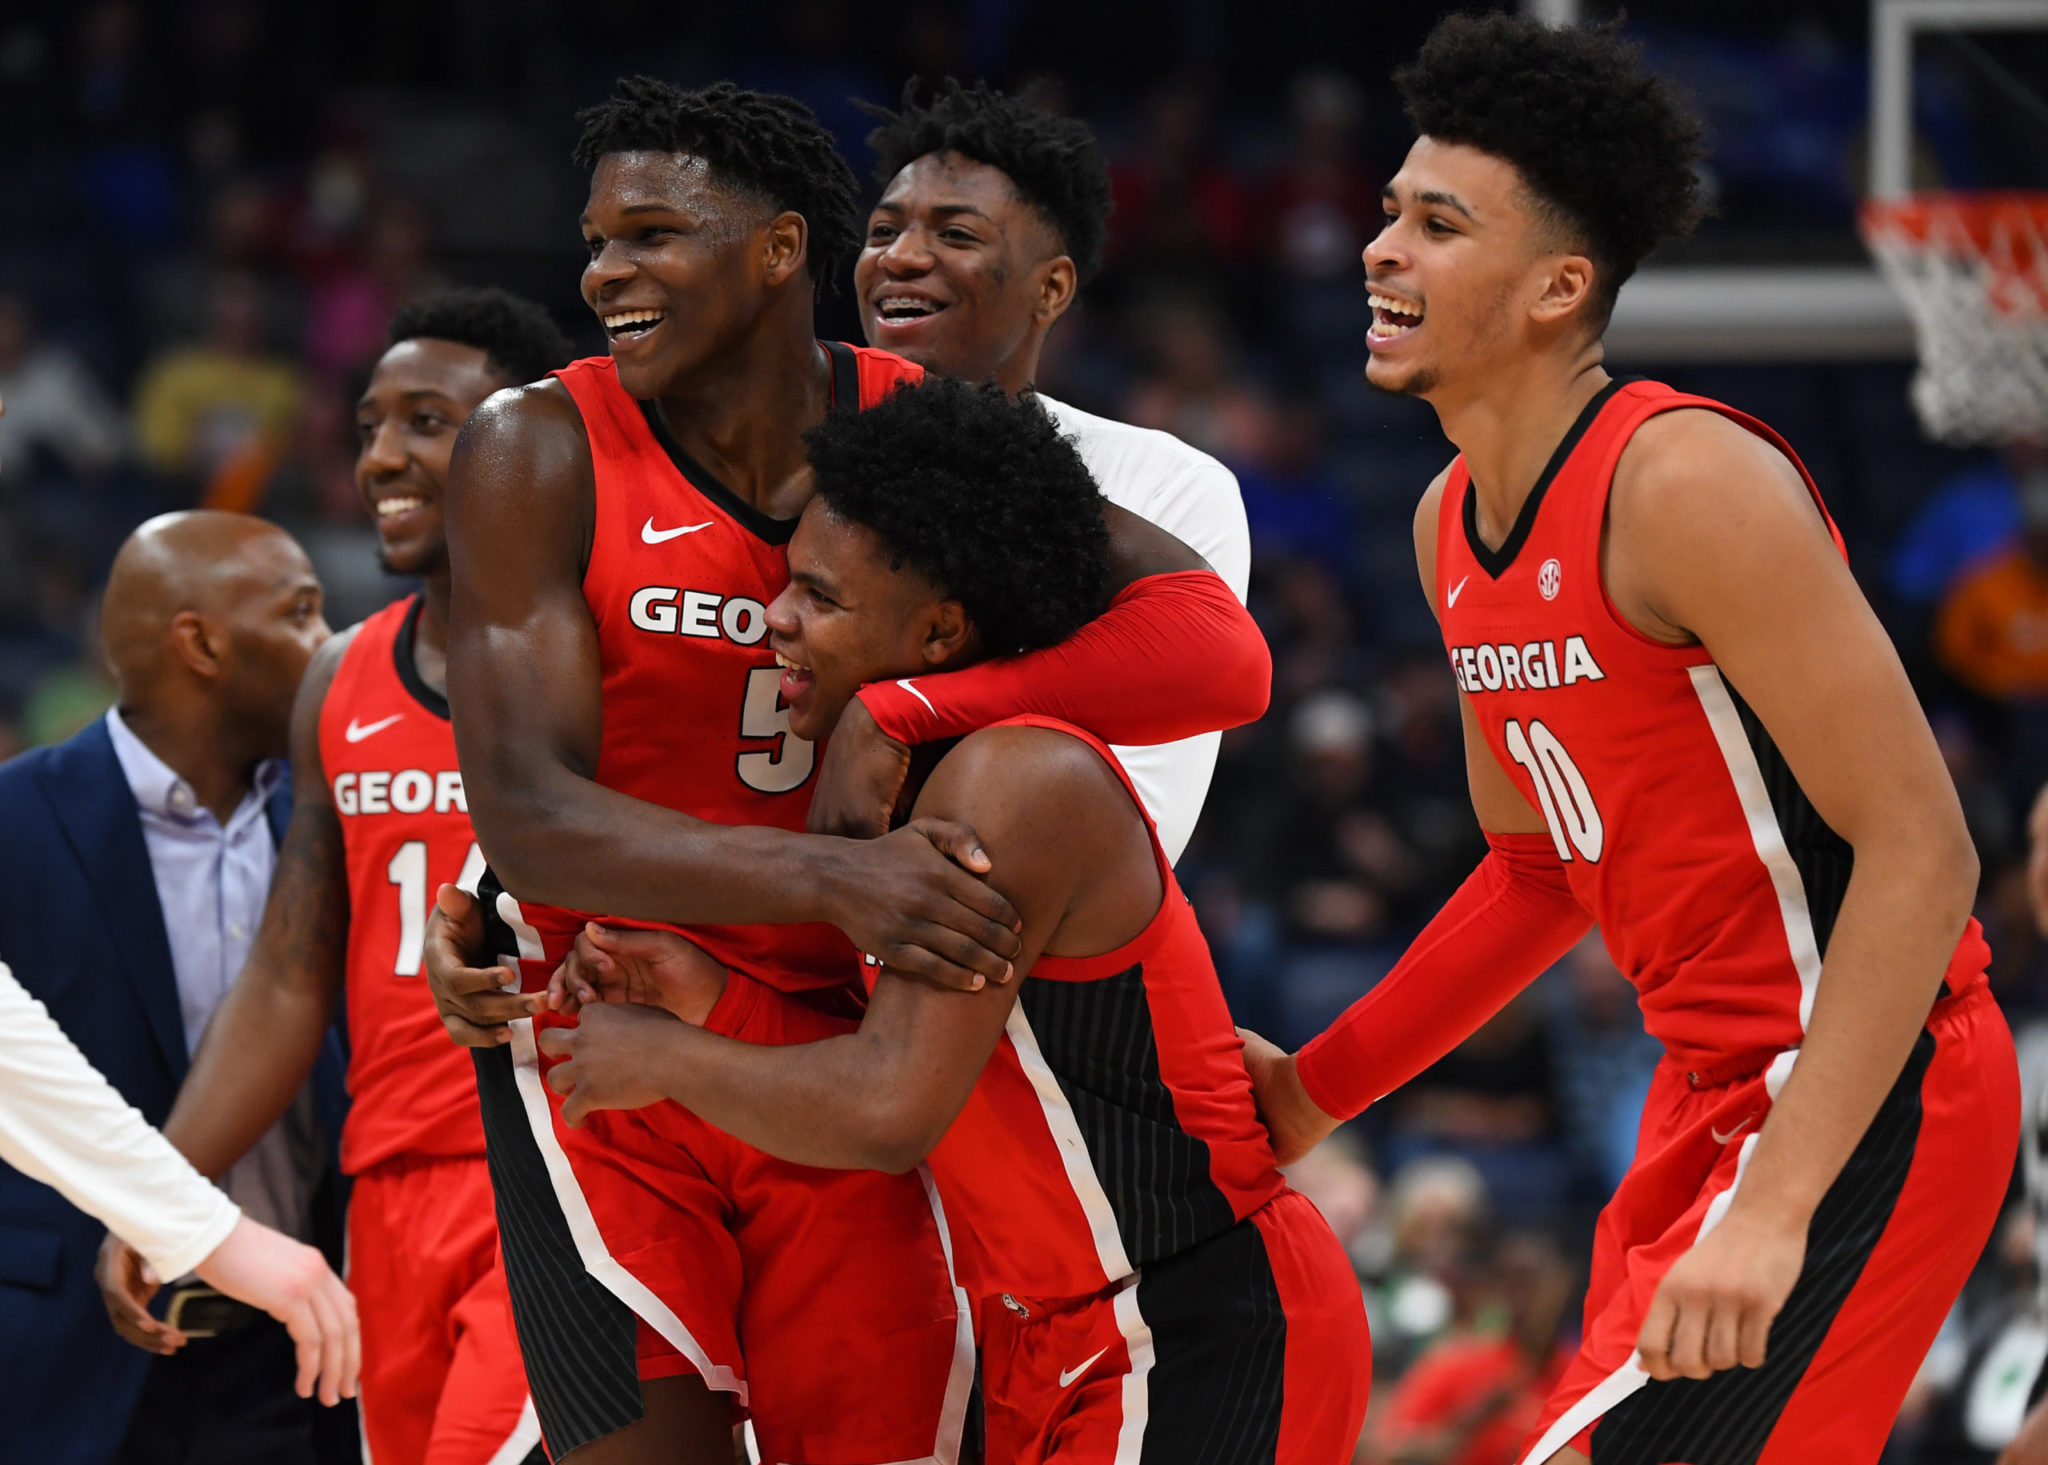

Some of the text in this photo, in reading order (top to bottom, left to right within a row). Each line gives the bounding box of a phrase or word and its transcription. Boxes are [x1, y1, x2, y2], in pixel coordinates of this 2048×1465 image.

[629, 585, 768, 645] GEO
[1451, 635, 1606, 692] GEORGIA
[735, 665, 818, 794] 5
[333, 769, 468, 816] GEOR
[1505, 718, 1604, 864] 10
[387, 840, 487, 977] 1
